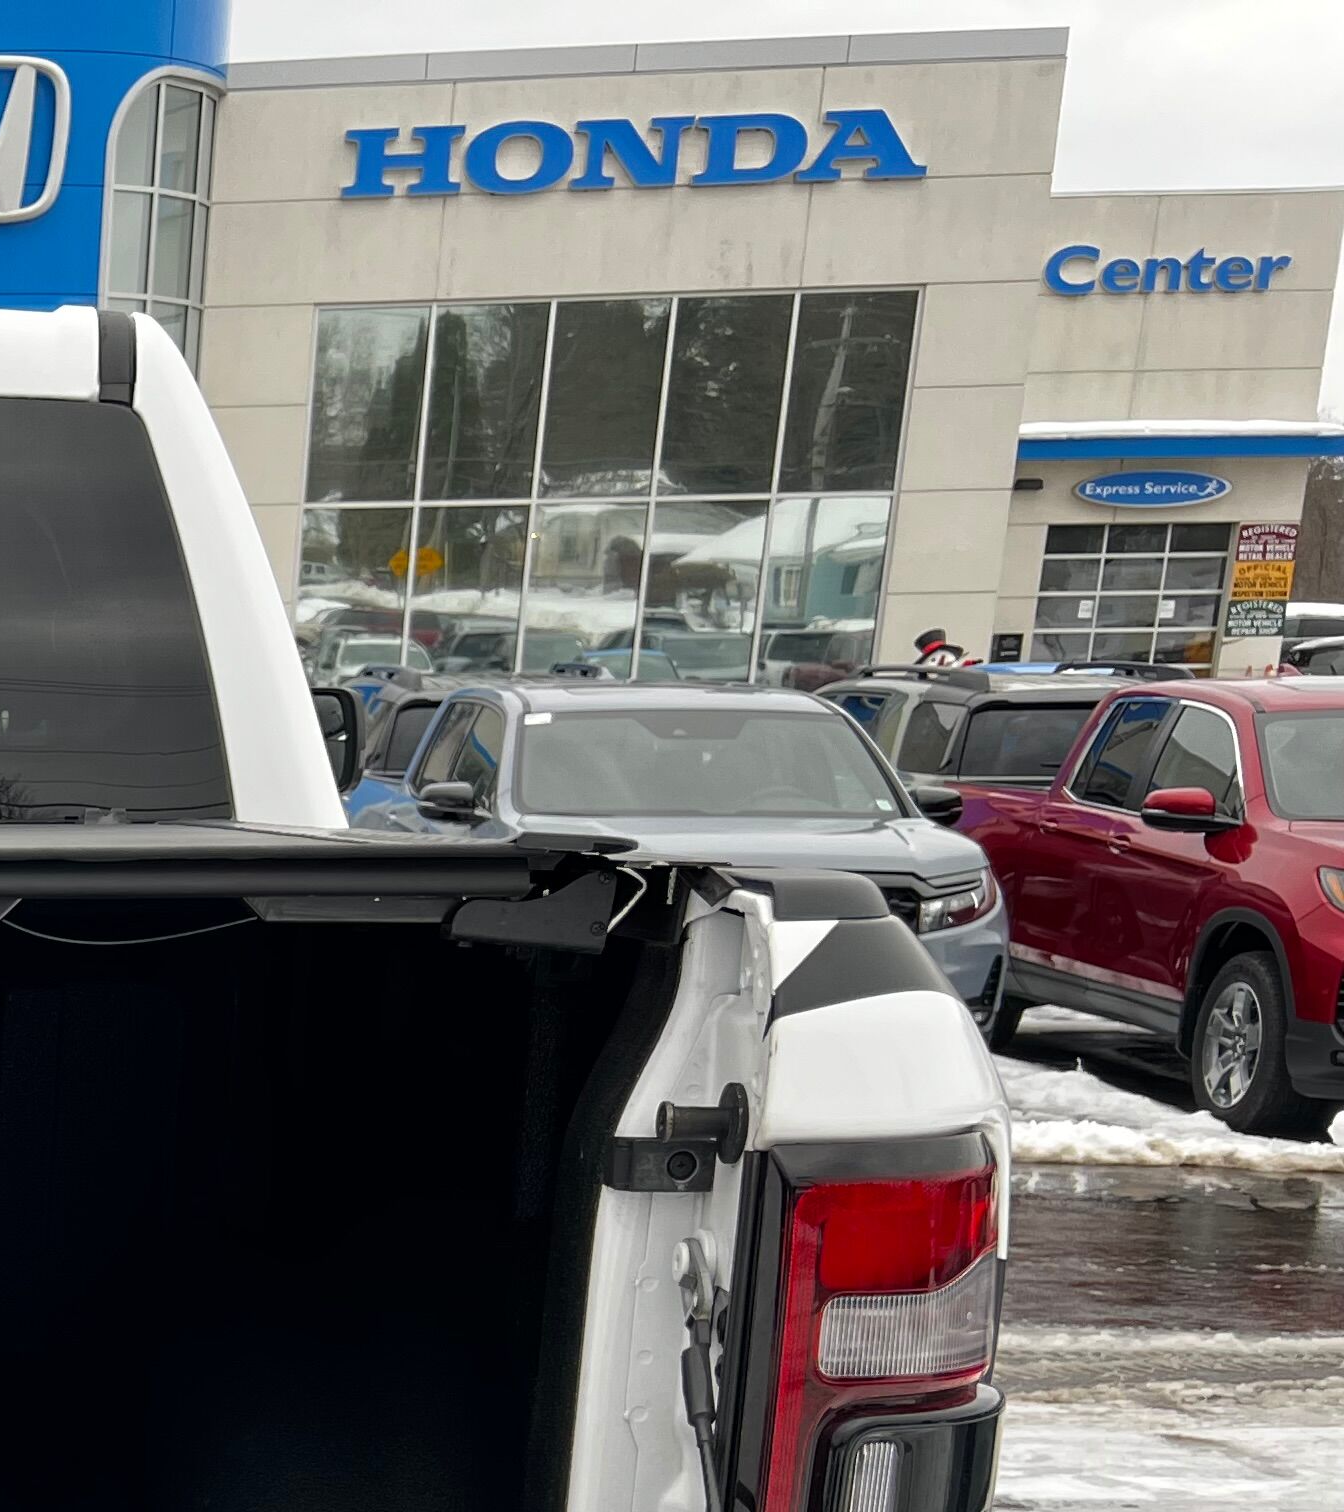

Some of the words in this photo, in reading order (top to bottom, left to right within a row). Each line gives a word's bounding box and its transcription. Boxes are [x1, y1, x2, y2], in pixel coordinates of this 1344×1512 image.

[341, 109, 928, 199] HONDA
[1044, 244, 1293, 296] Center
[1085, 483, 1140, 498] Express
[1144, 482, 1198, 495] Service
